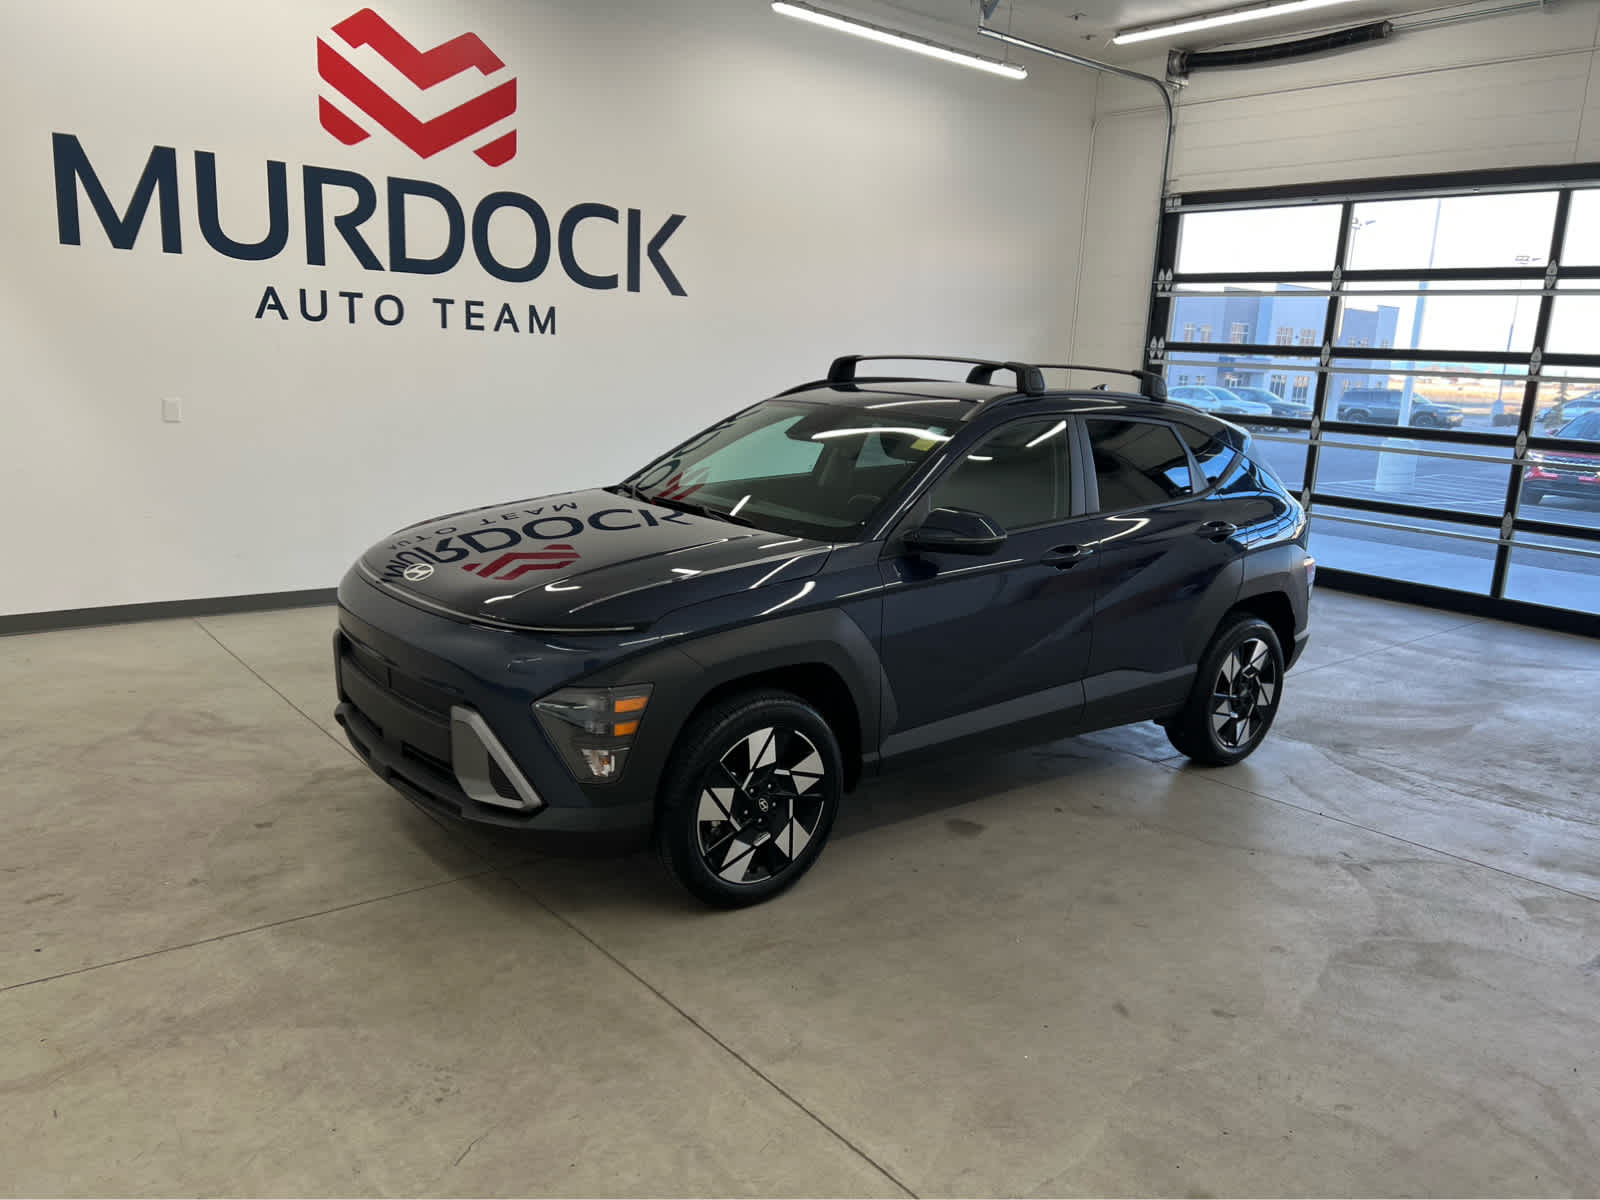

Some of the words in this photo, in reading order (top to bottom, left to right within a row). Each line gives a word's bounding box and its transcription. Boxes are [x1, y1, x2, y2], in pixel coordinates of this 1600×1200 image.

[52, 132, 688, 297] MURDOCK
[255, 286, 405, 326] AUTO
[432, 297, 557, 335] TEAM
